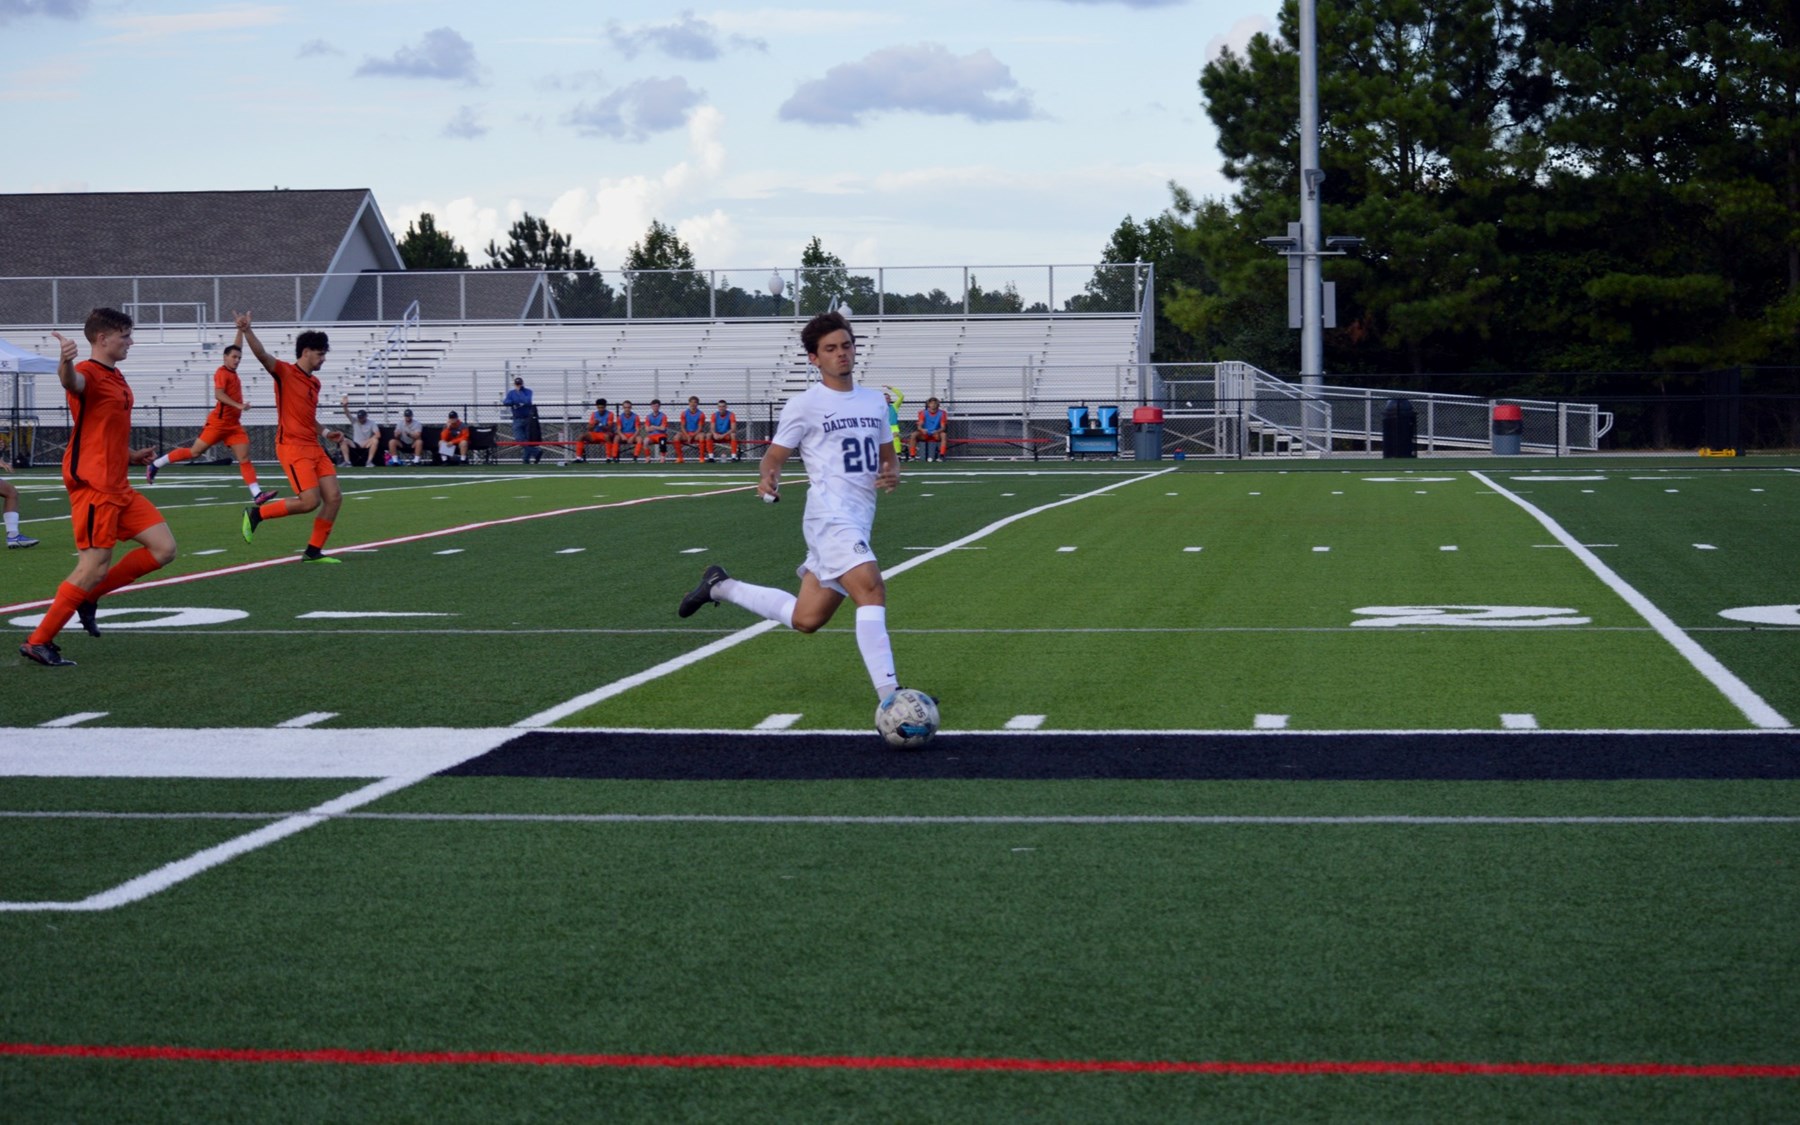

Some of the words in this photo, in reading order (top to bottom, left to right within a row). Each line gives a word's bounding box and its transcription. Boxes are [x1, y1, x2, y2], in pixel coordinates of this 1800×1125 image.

[822, 417, 859, 433] DALTON
[860, 417, 882, 430] STAT
[842, 437, 878, 473] 20
